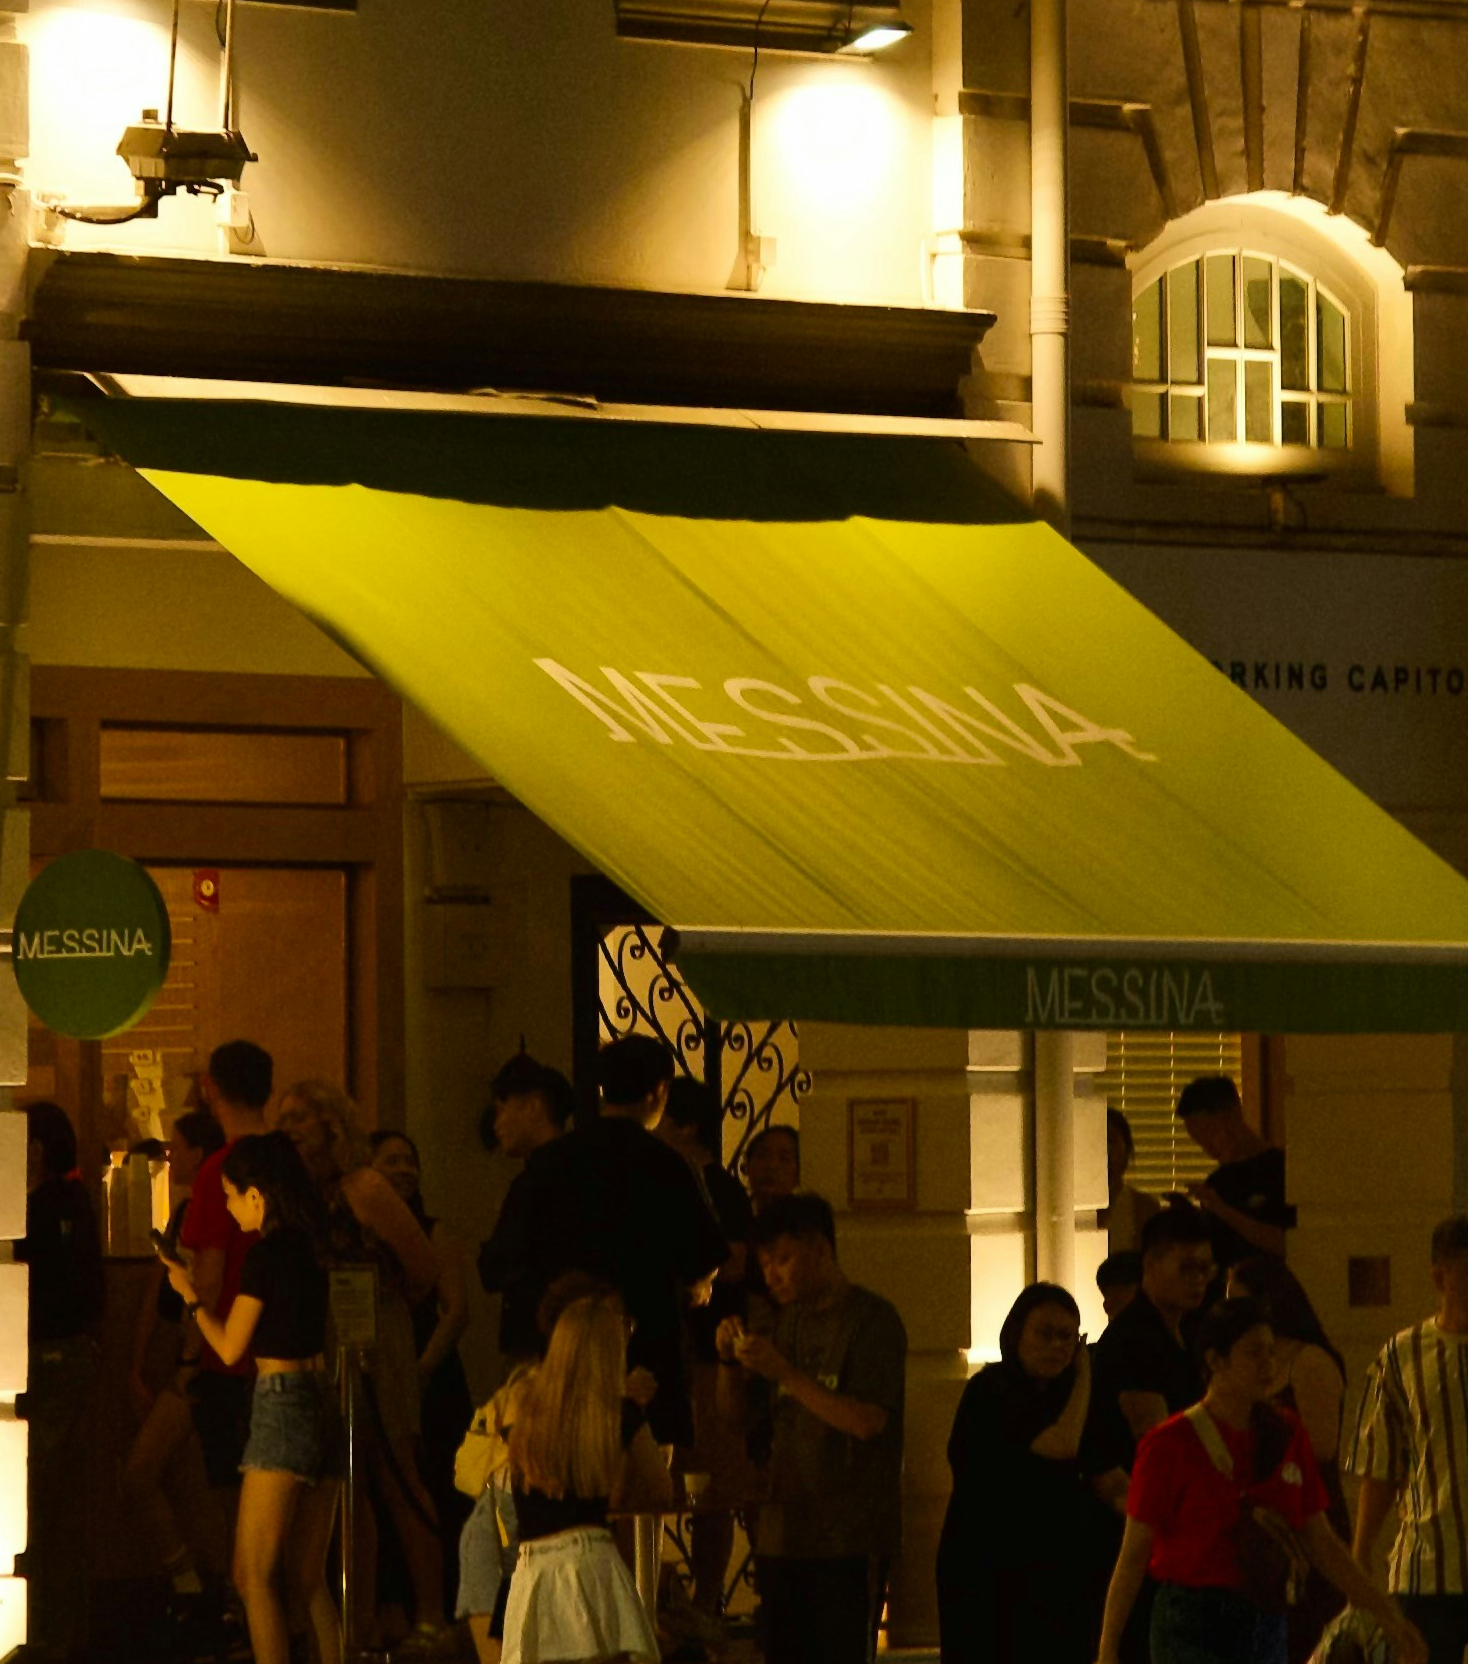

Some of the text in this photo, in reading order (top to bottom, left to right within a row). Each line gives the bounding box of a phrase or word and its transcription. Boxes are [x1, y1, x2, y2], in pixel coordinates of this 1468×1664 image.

[1211, 658, 1327, 692] RKING
[531, 656, 1158, 767] MESSINA
[17, 927, 153, 960] MESSINA
[1025, 966, 1225, 1025] MESSINA
